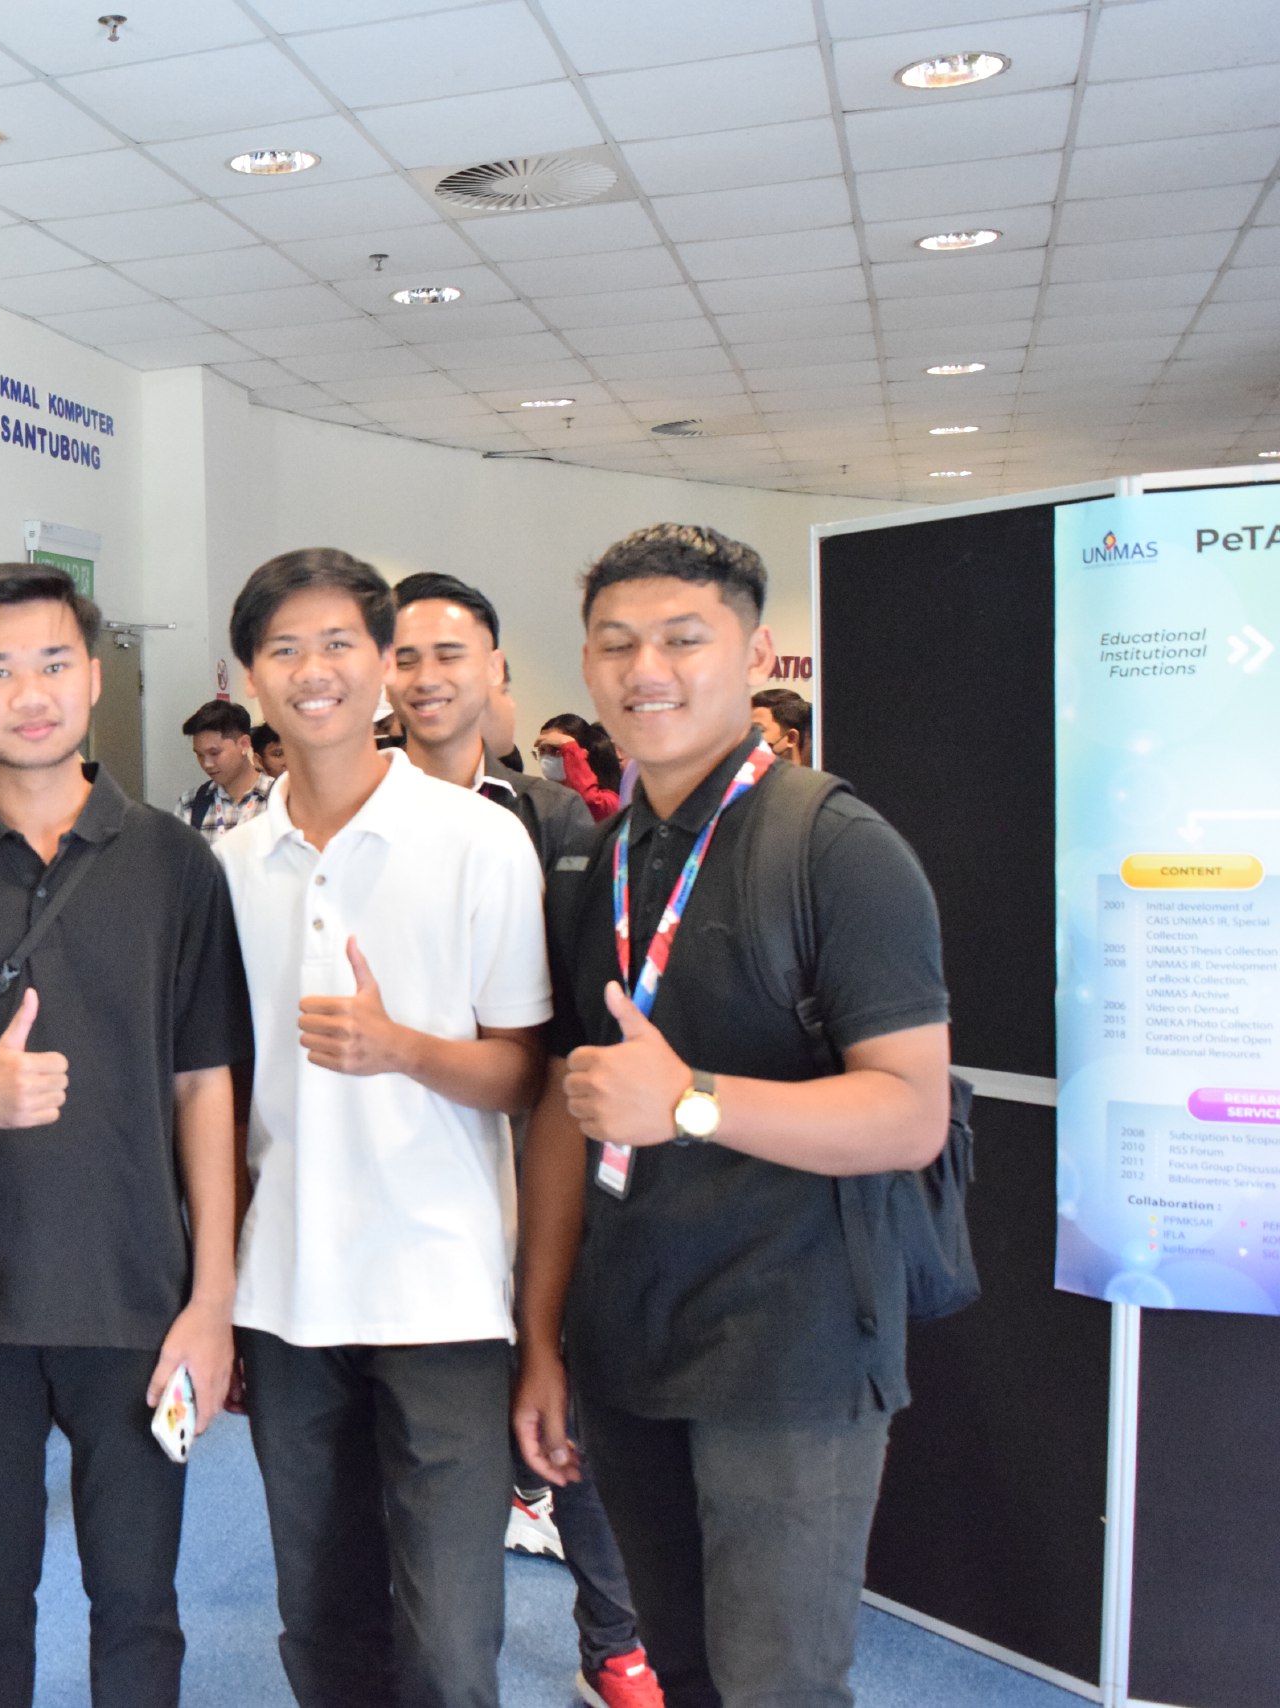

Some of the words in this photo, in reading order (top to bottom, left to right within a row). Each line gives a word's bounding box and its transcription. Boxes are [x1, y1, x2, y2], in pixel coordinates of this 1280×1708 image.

[48, 393, 114, 436] KOMPUTER
[1, 415, 100, 470] SANTUBONG
[1196, 524, 1280, 553] PeTA
[1100, 628, 1207, 646] Educational
[1100, 645, 1207, 662] Institutional
[1109, 663, 1196, 678] Functions
[1160, 866, 1222, 876] CONTENT
[1104, 901, 1125, 910] 2001
[1146, 902, 1174, 911] Initial
[1242, 902, 1254, 911] of
[1146, 916, 1170, 926] CAIS
[1172, 916, 1216, 926] UNIMAS
[1233, 917, 1270, 928] Special
[1146, 930, 1198, 940] Collection
[1146, 945, 1189, 954] UNIMAS
[1191, 946, 1222, 955] Thesis
[1224, 946, 1278, 956] Collection
[1146, 960, 1189, 970] UNIMAS
[1206, 961, 1278, 972] Development
[1146, 974, 1157, 984] of
[1146, 989, 1189, 998] UNIMAS
[1191, 990, 1230, 1000] Archive
[1146, 1003, 1175, 1012] Video
[1194, 1005, 1238, 1014] Demand
[1187, 1018, 1218, 1028] Photo
[1220, 1020, 1274, 1030] Collection
[1146, 1032, 1190, 1042] Curation
[1192, 1032, 1202, 1042] of
[1205, 1034, 1239, 1044] Online
[1242, 1035, 1272, 1046] Open
[1146, 1046, 1206, 1057] Educational
[1208, 1048, 1261, 1059] Resources
[1232, 1132, 1243, 1142] to
[1120, 1141, 1146, 1152] 2010
[1190, 1146, 1224, 1157] Forum
[1120, 1156, 1144, 1166] 2011
[1169, 1160, 1198, 1170] Focus
[1201, 1161, 1234, 1174] Group
[1169, 1174, 1230, 1187] Bibliometric
[1234, 1178, 1276, 1190] Services
[1128, 1194, 1214, 1211] Collaboration
